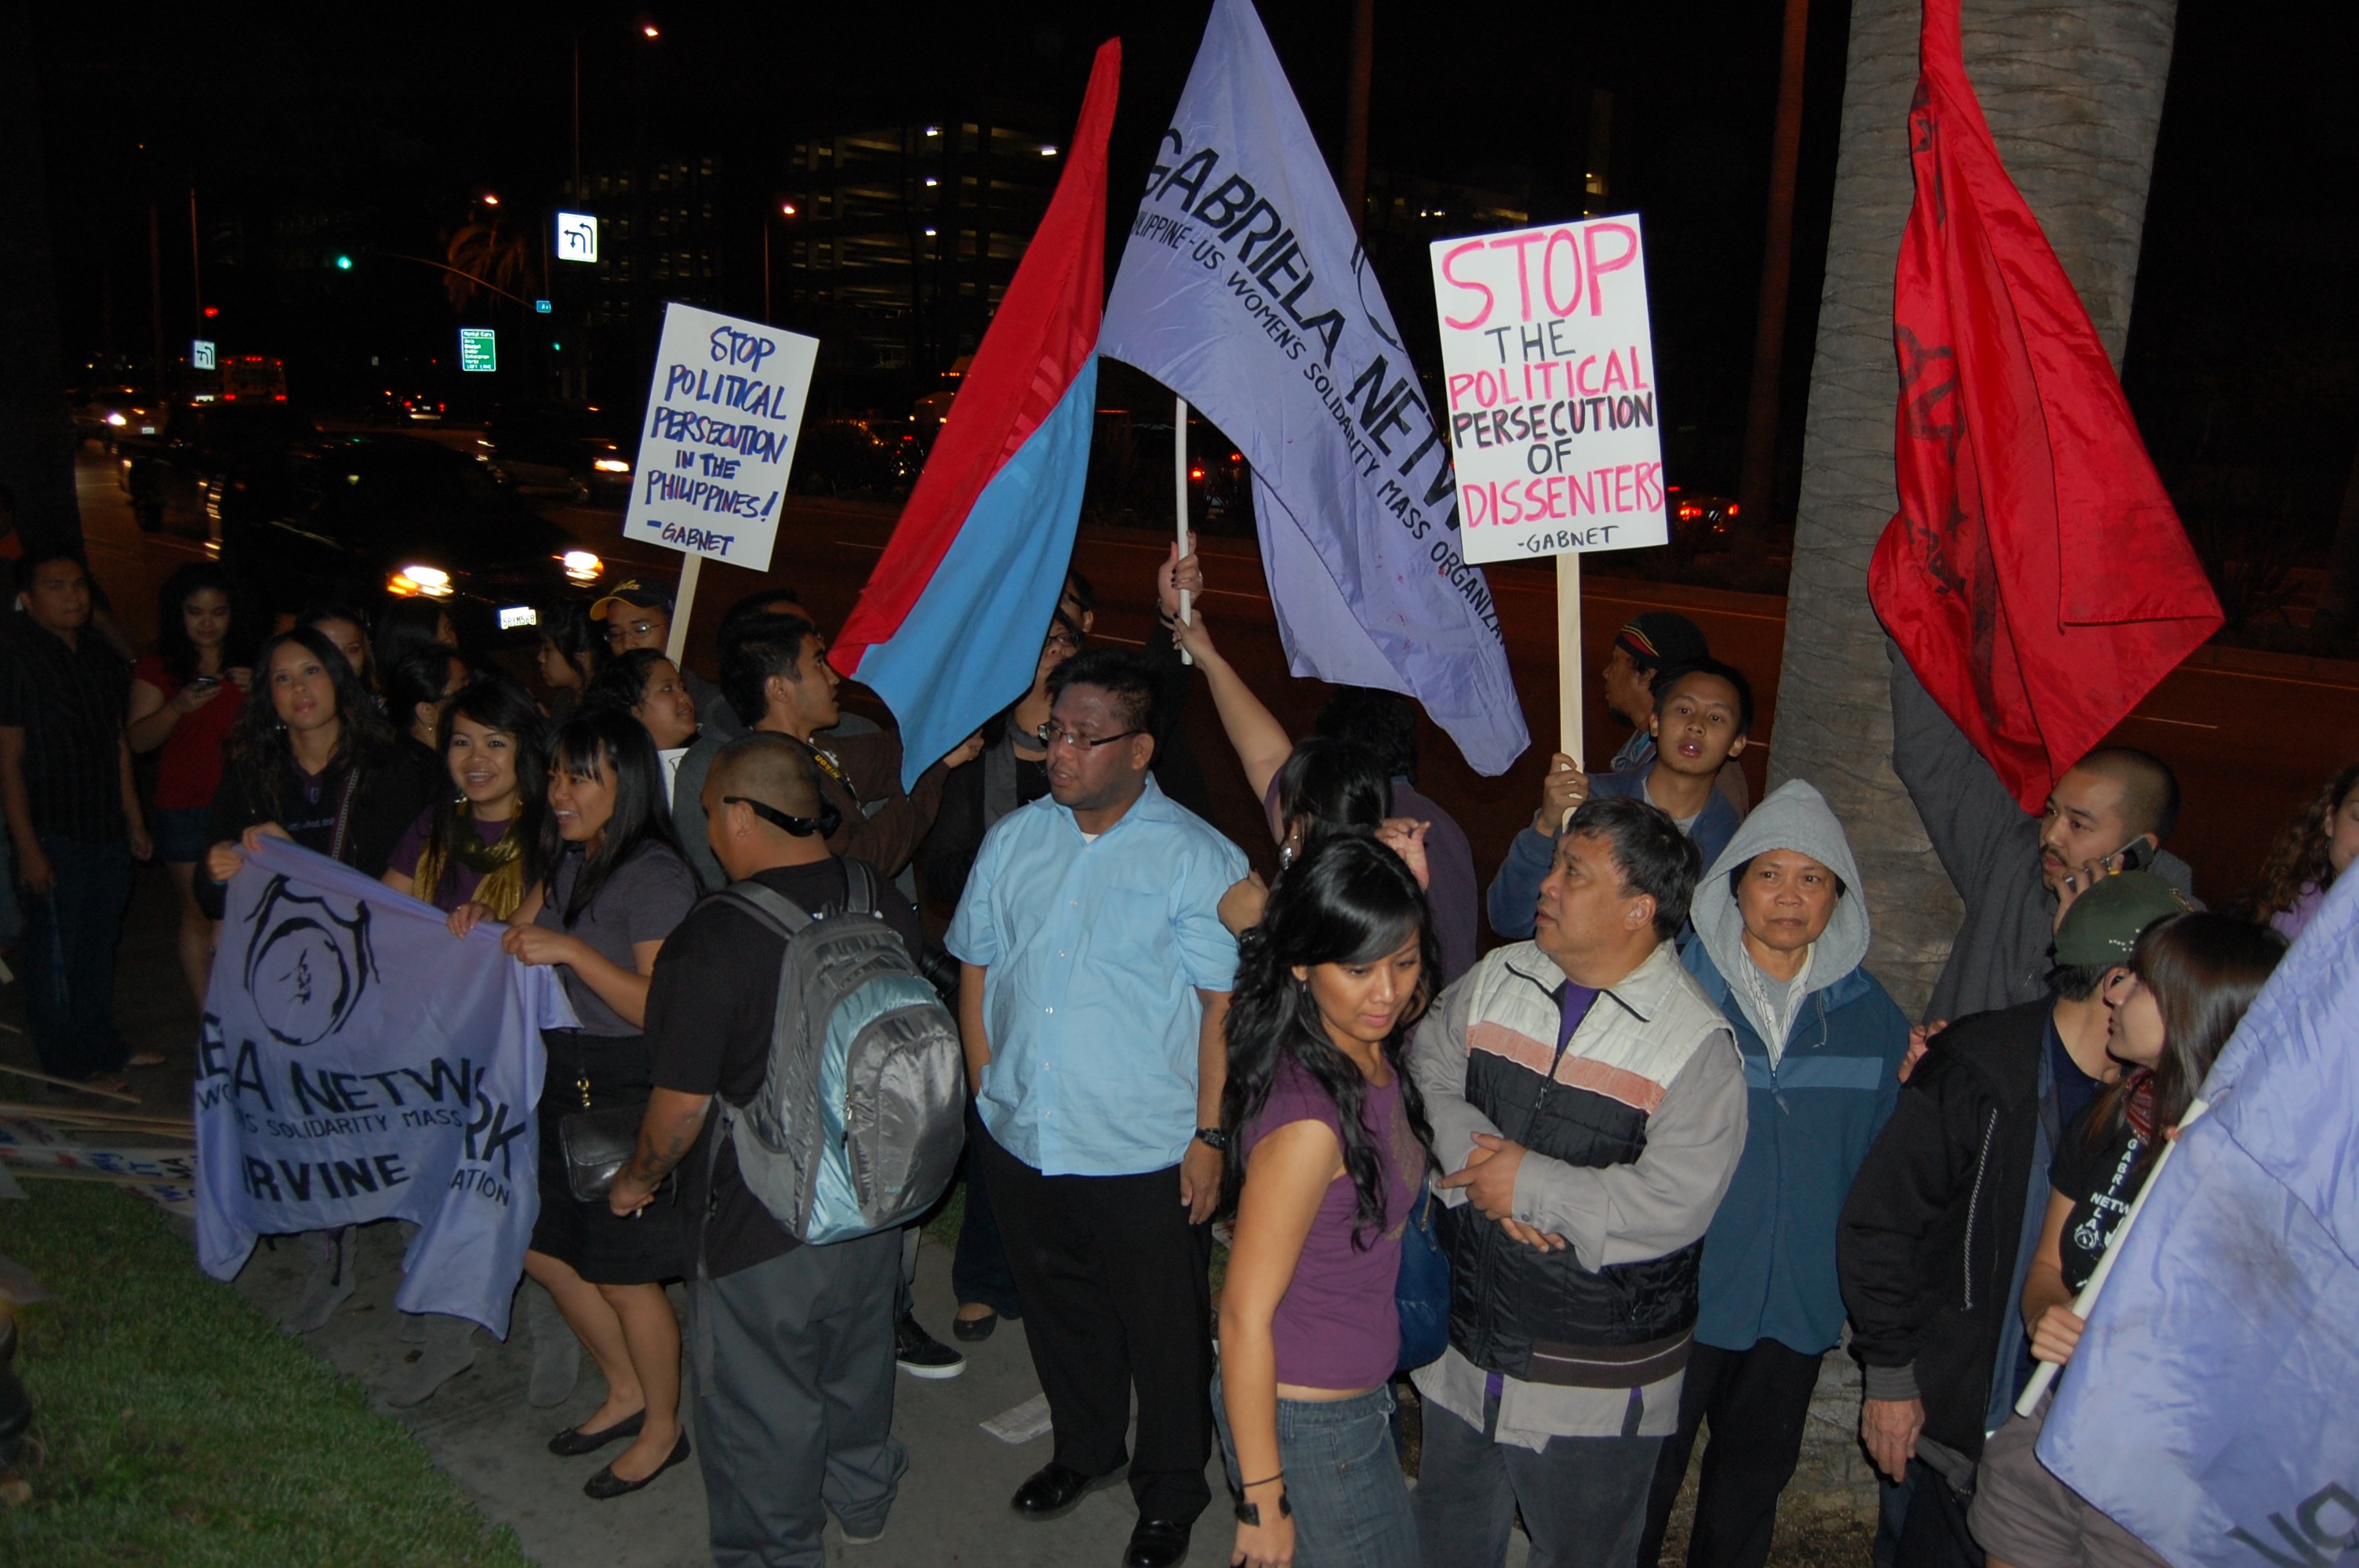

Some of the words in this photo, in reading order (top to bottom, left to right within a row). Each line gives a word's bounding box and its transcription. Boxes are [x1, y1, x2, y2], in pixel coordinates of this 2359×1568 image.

[1441, 222, 1637, 330] STOP
[710, 325, 776, 372] STOP
[1485, 319, 1576, 364] THE
[664, 364, 787, 420] POLITICAL
[1449, 346, 1648, 411] POLITICAL
[650, 406, 788, 464] PERSECUTION
[1344, 354, 1461, 532] NETW
[1452, 392, 1653, 449] PERSECUTION
[675, 449, 695, 469] IN
[700, 452, 741, 480] THE
[1227, 270, 1307, 360] WOMEN'S
[1303, 362, 1380, 478] SOLIDARITY
[1376, 479, 1430, 539] MASS
[1430, 541, 1504, 645] ORGANIZA
[1527, 438, 1573, 474] OF
[645, 470, 779, 522] PHILIPPINES!
[1462, 461, 1663, 528] DISSENTERS
[266, 1114, 388, 1138] SOLIDARITY
[402, 1108, 463, 1128] MASS
[242, 1154, 411, 1203] IRVINE
[2089, 1191, 2130, 1216] NETW
